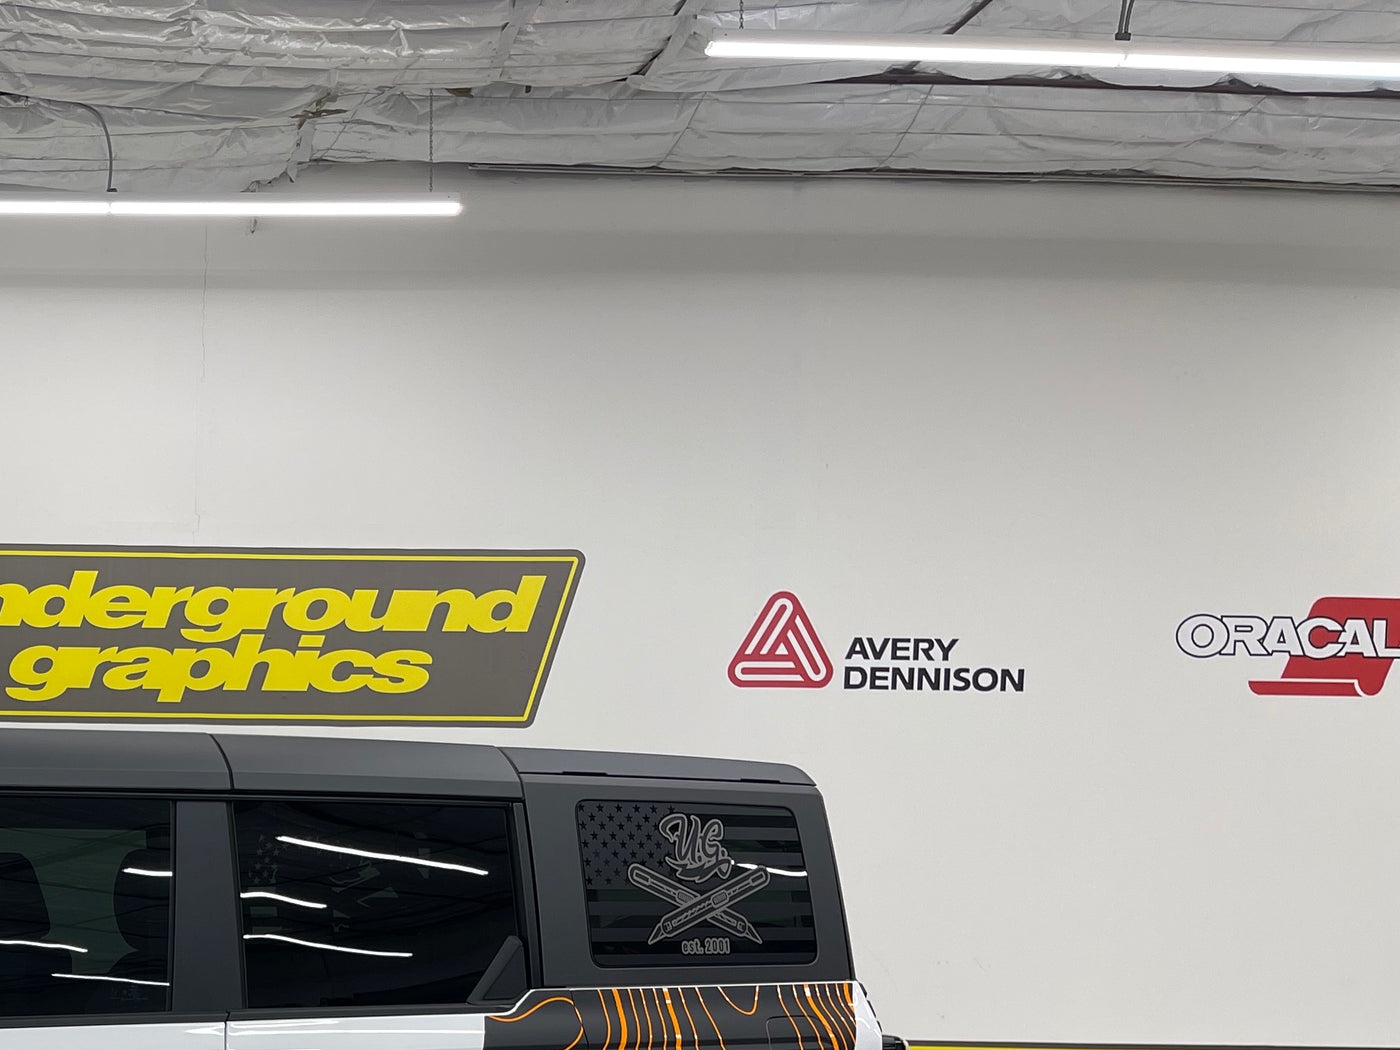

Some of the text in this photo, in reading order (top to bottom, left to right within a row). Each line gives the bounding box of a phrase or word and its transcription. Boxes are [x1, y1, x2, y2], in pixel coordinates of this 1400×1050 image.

[844, 637, 960, 661] AVERY
[5, 634, 433, 703] graphics
[843, 666, 1025, 692] DENNISON
[681, 937, 731, 955] est. 2001
